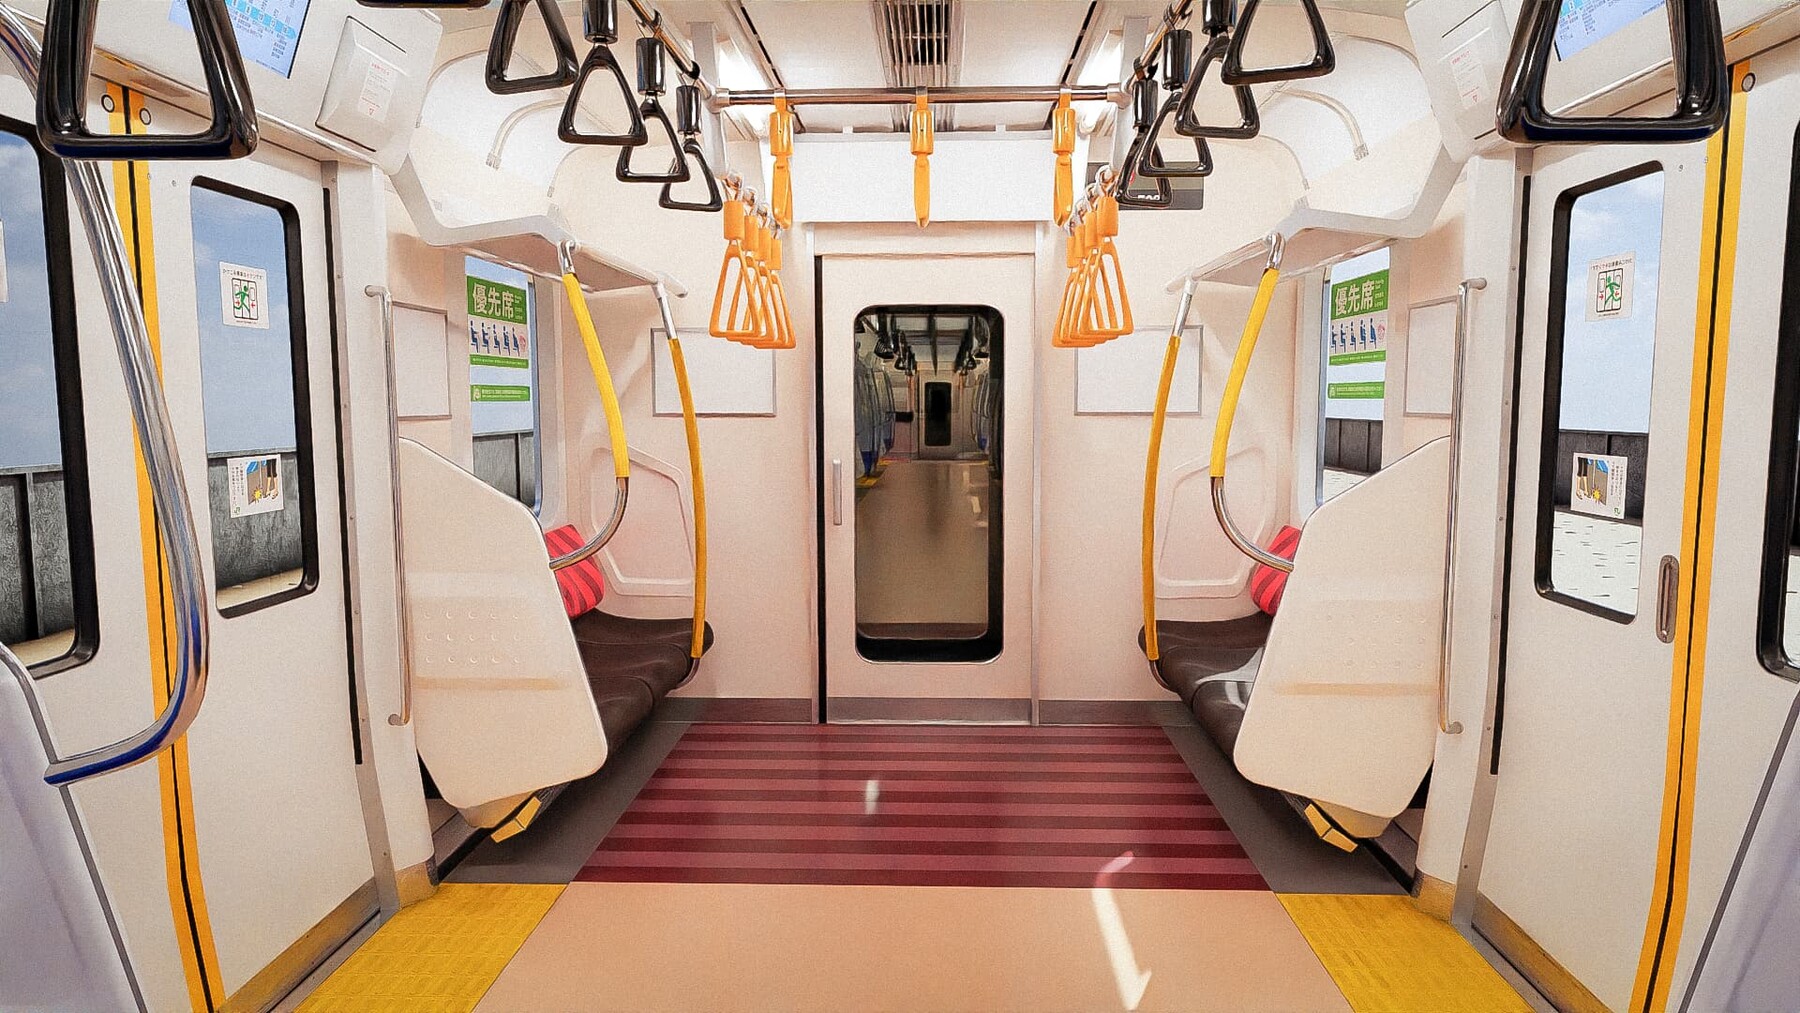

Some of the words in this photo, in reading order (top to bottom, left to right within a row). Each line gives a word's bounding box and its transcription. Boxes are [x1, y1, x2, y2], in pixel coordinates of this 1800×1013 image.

[473, 282, 514, 319] 優先席
[1335, 280, 1375, 316] 優先席
